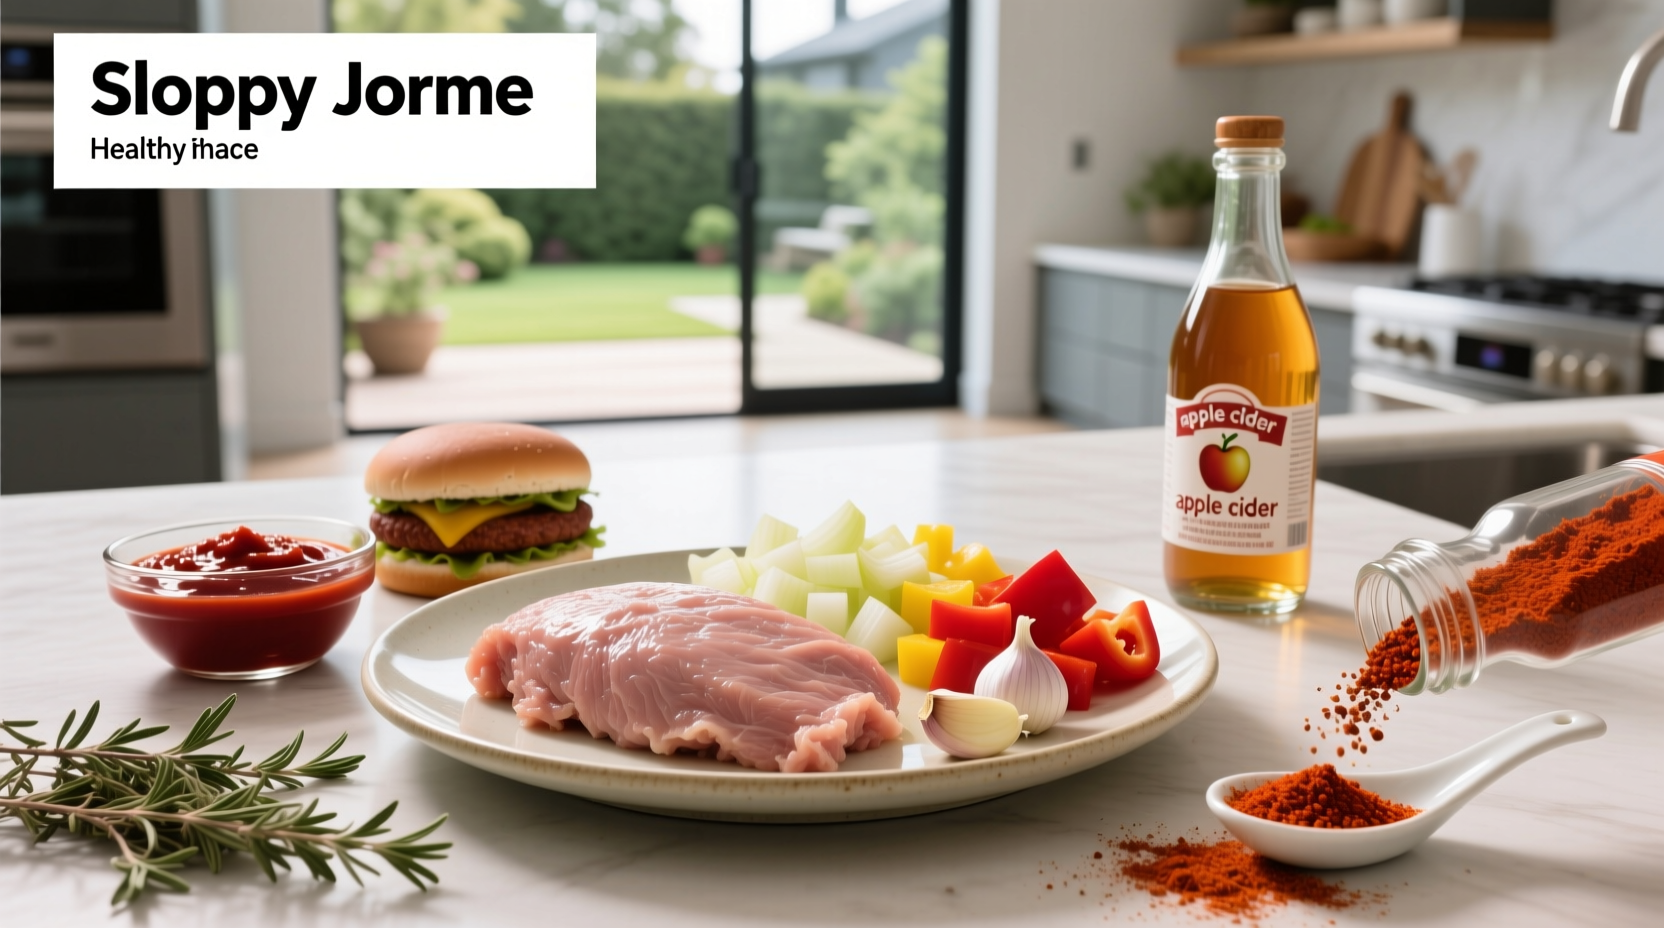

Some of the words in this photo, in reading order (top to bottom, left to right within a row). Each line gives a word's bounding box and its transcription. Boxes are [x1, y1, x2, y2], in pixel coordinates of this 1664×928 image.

[1180, 404, 1226, 430] apple
[1229, 407, 1278, 434] cider
[1176, 494, 1223, 518] apple
[1228, 496, 1279, 518] cider
